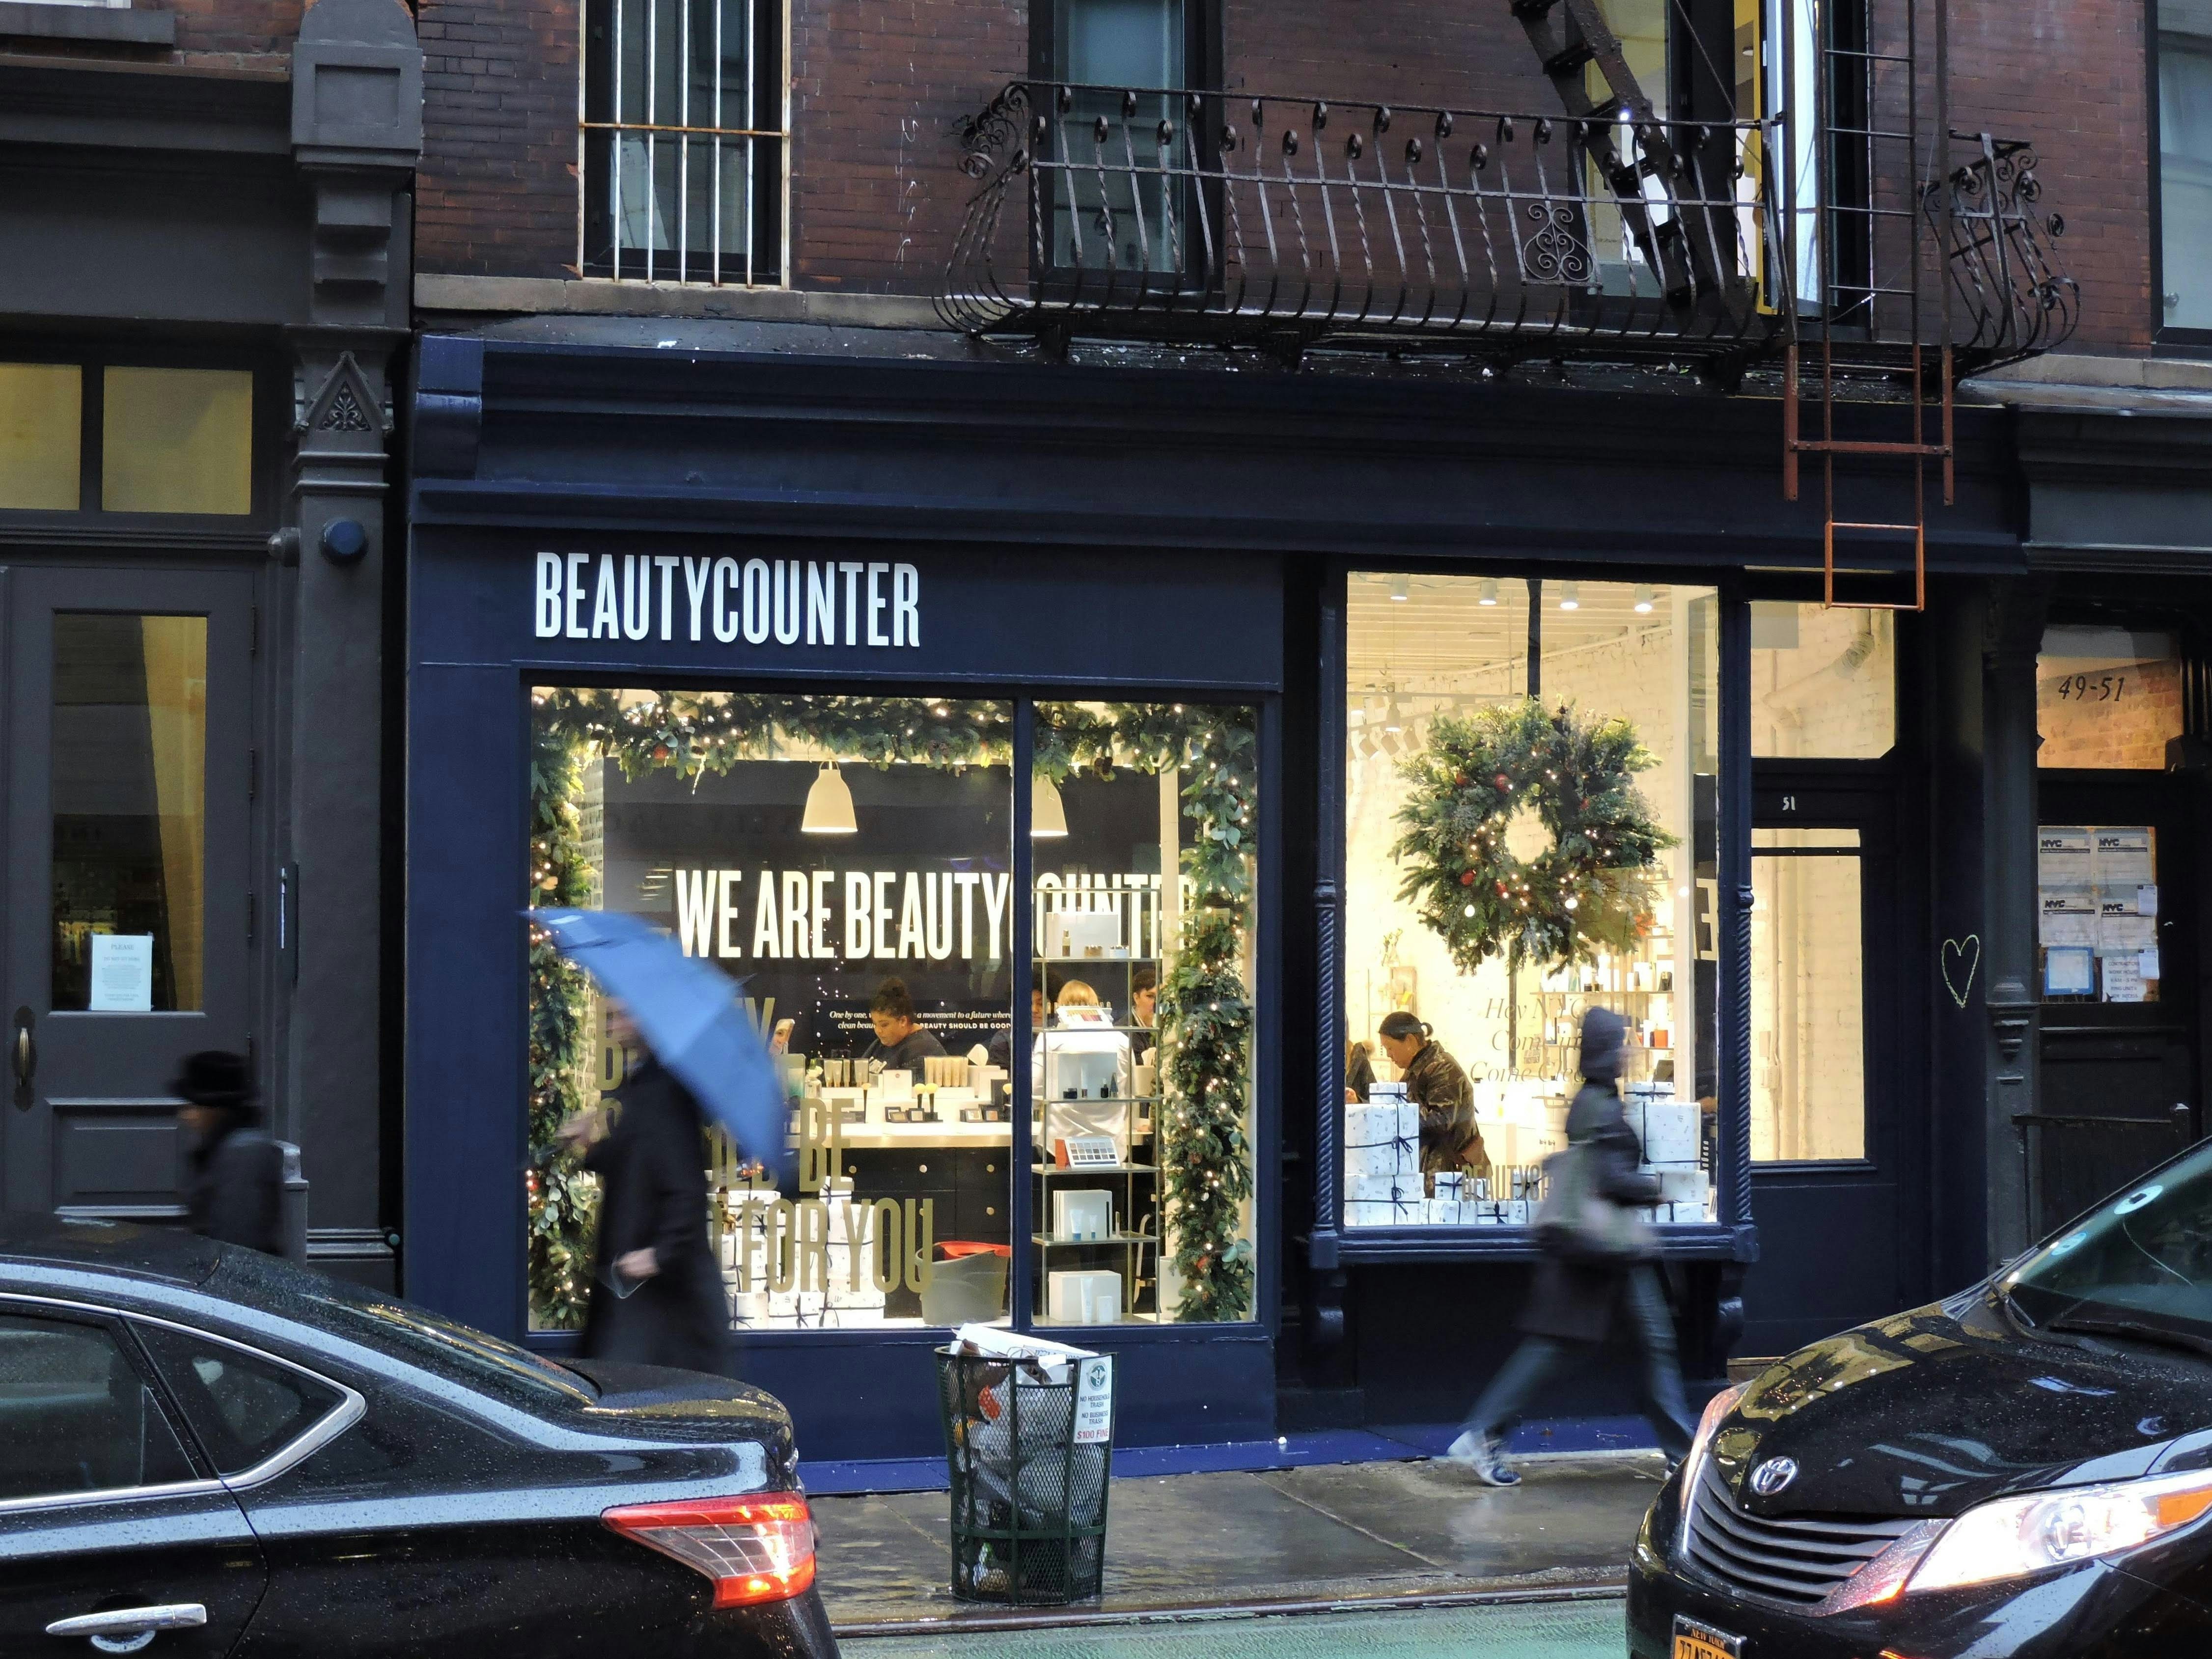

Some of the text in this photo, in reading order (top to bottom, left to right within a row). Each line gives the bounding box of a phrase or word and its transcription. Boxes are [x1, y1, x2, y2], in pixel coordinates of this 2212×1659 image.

[535, 552, 920, 647] BEAUTYCOUNTER
[2058, 675, 2125, 702] 49-51
[1782, 796, 1796, 811] 51
[2041, 839, 2062, 848] NYC
[2099, 838, 2120, 847] NYC
[2045, 900, 2066, 909] NYC
[2102, 904, 2123, 912] NYC
[676, 870, 741, 958] WE
[752, 871, 834, 959] ARE
[845, 1010, 853, 1020] by
[969, 1011, 992, 1020] future
[837, 1021, 876, 1029] clean beau
[1470, 1061, 1532, 1082] Come
[799, 1098, 855, 1192] BE
[742, 1198, 828, 1294] FOR
[841, 1197, 934, 1294] YOU
[1089, 1410, 1108, 1418] BUSINESS
[1077, 1428, 1108, 1439] $100 FINE
[1691, 1628, 1706, 1640] NEW
